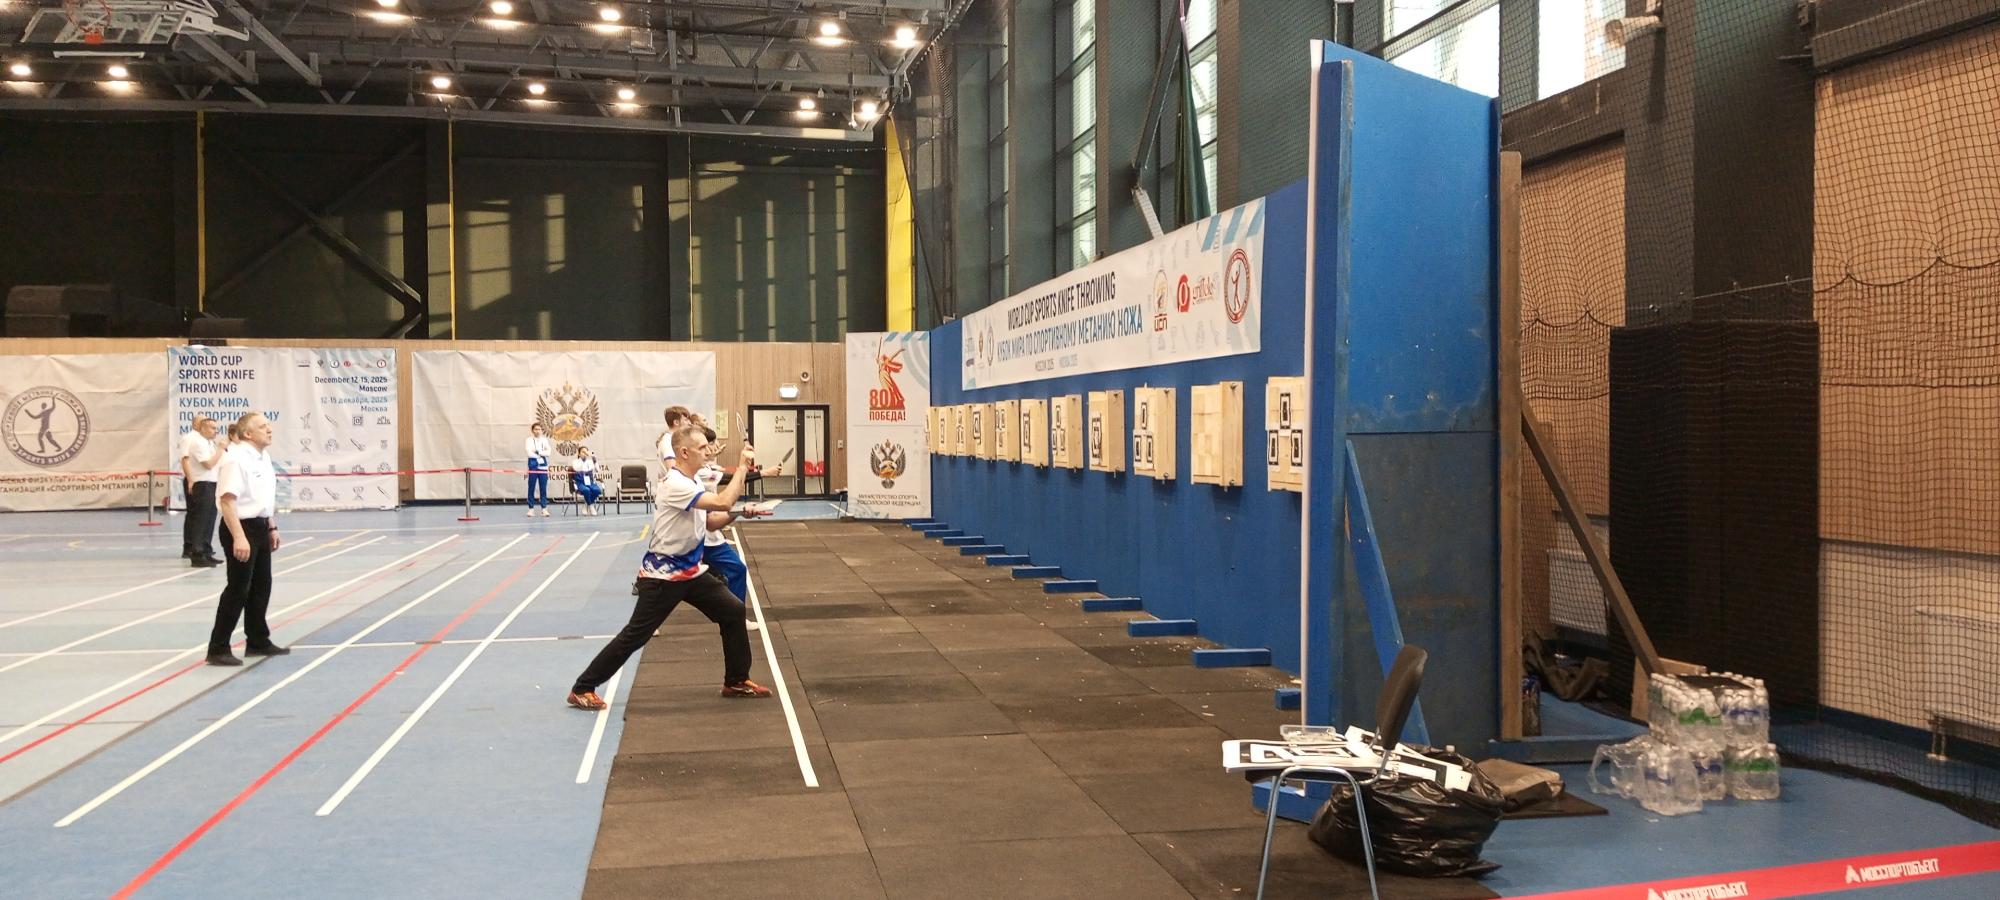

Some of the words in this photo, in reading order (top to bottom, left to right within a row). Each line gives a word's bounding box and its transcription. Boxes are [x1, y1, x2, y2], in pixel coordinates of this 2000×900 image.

[1007, 305, 1024, 331] WORLD
[1024, 301, 1034, 326] CUP
[1034, 293, 1057, 322] SPORTS
[1057, 286, 1075, 316] KNIFE
[1076, 271, 1116, 309] THROWING
[1033, 321, 1077, 355] СПОРТИВНОМУ
[1078, 310, 1116, 345] МЕТАНИЮ
[1117, 303, 1143, 337] НОЖА
[179, 355, 218, 366] WORLD
[221, 355, 243, 366] CUP
[179, 369, 220, 380] SPORTS
[224, 369, 255, 380] KNIFE
[314, 376, 350, 384] December
[179, 383, 238, 394] THROWING
[179, 397, 215, 408] КУБОК
[218, 397, 249, 408] МИРА
[869, 389, 889, 408] 80
[179, 411, 194, 421] ПО
[869, 410, 906, 423] ПОБЕДА!
[101, 482, 136, 490] МЕТАНИЕ
[1860, 858, 1940, 882] МОССПОРТОБЪЕКТ
